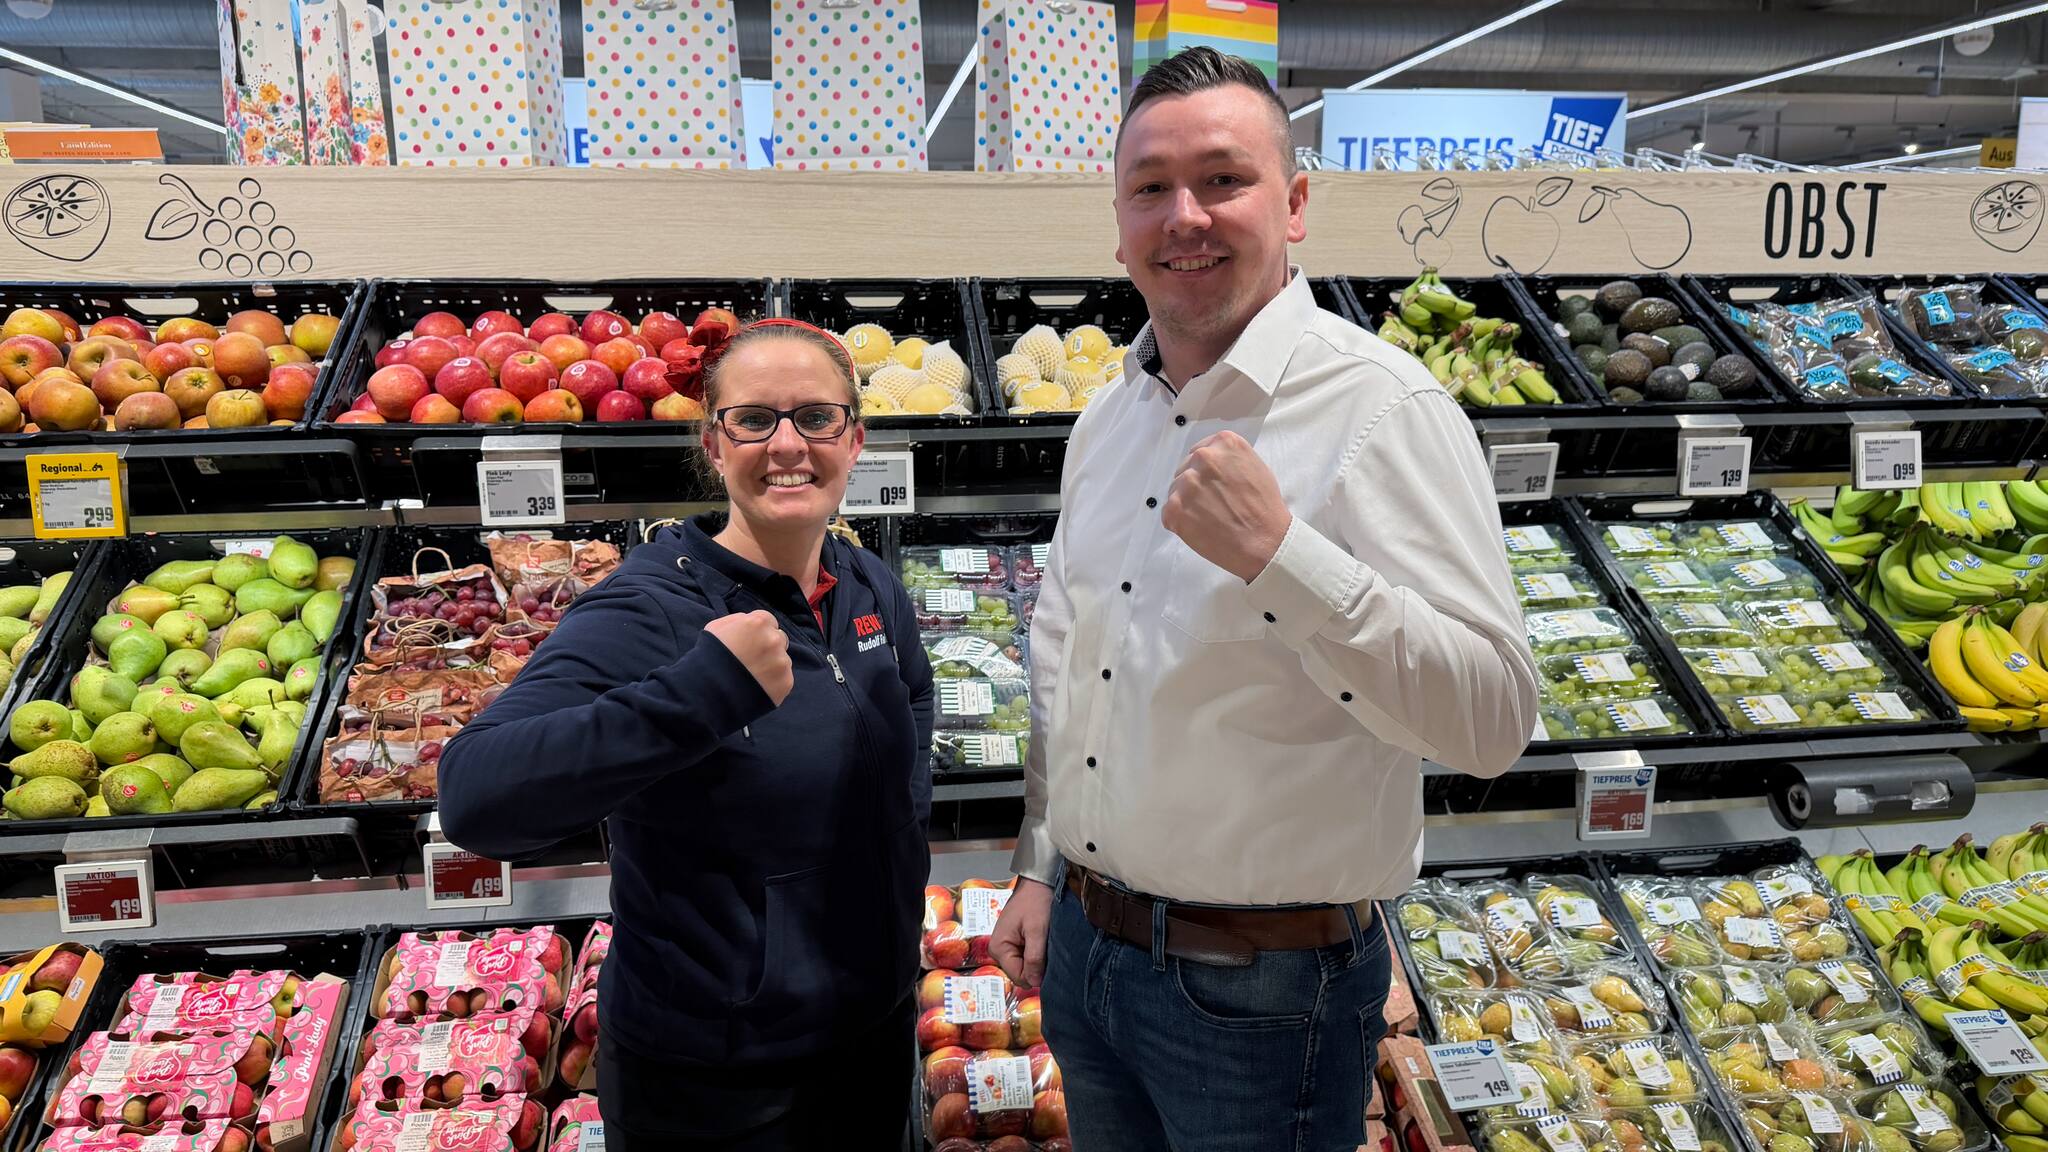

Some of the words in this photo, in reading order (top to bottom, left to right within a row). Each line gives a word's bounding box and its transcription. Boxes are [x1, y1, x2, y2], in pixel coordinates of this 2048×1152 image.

[1551, 112, 1605, 151] TIEF
[1764, 181, 1888, 259] OBST
[40, 463, 82, 474] Regional
[853, 614, 884, 637] REW
[857, 634, 881, 653] Rudolf
[1592, 774, 1632, 784] TIEFPREIS
[86, 872, 116, 880] AKTION
[482, 958, 508, 973] Pink
[194, 1004, 221, 1017] Pink
[1952, 1016, 1991, 1024] TIEFPREIS
[293, 1046, 315, 1082] Pink
[306, 1016, 328, 1048] Lady
[466, 1036, 494, 1054] Pink
[1433, 1046, 1475, 1058] TIEFPREIS
[142, 1057, 174, 1069] Lady
[143, 1064, 175, 1080] Pink
[446, 1126, 474, 1145] Pink
[588, 1127, 604, 1136] TIE
